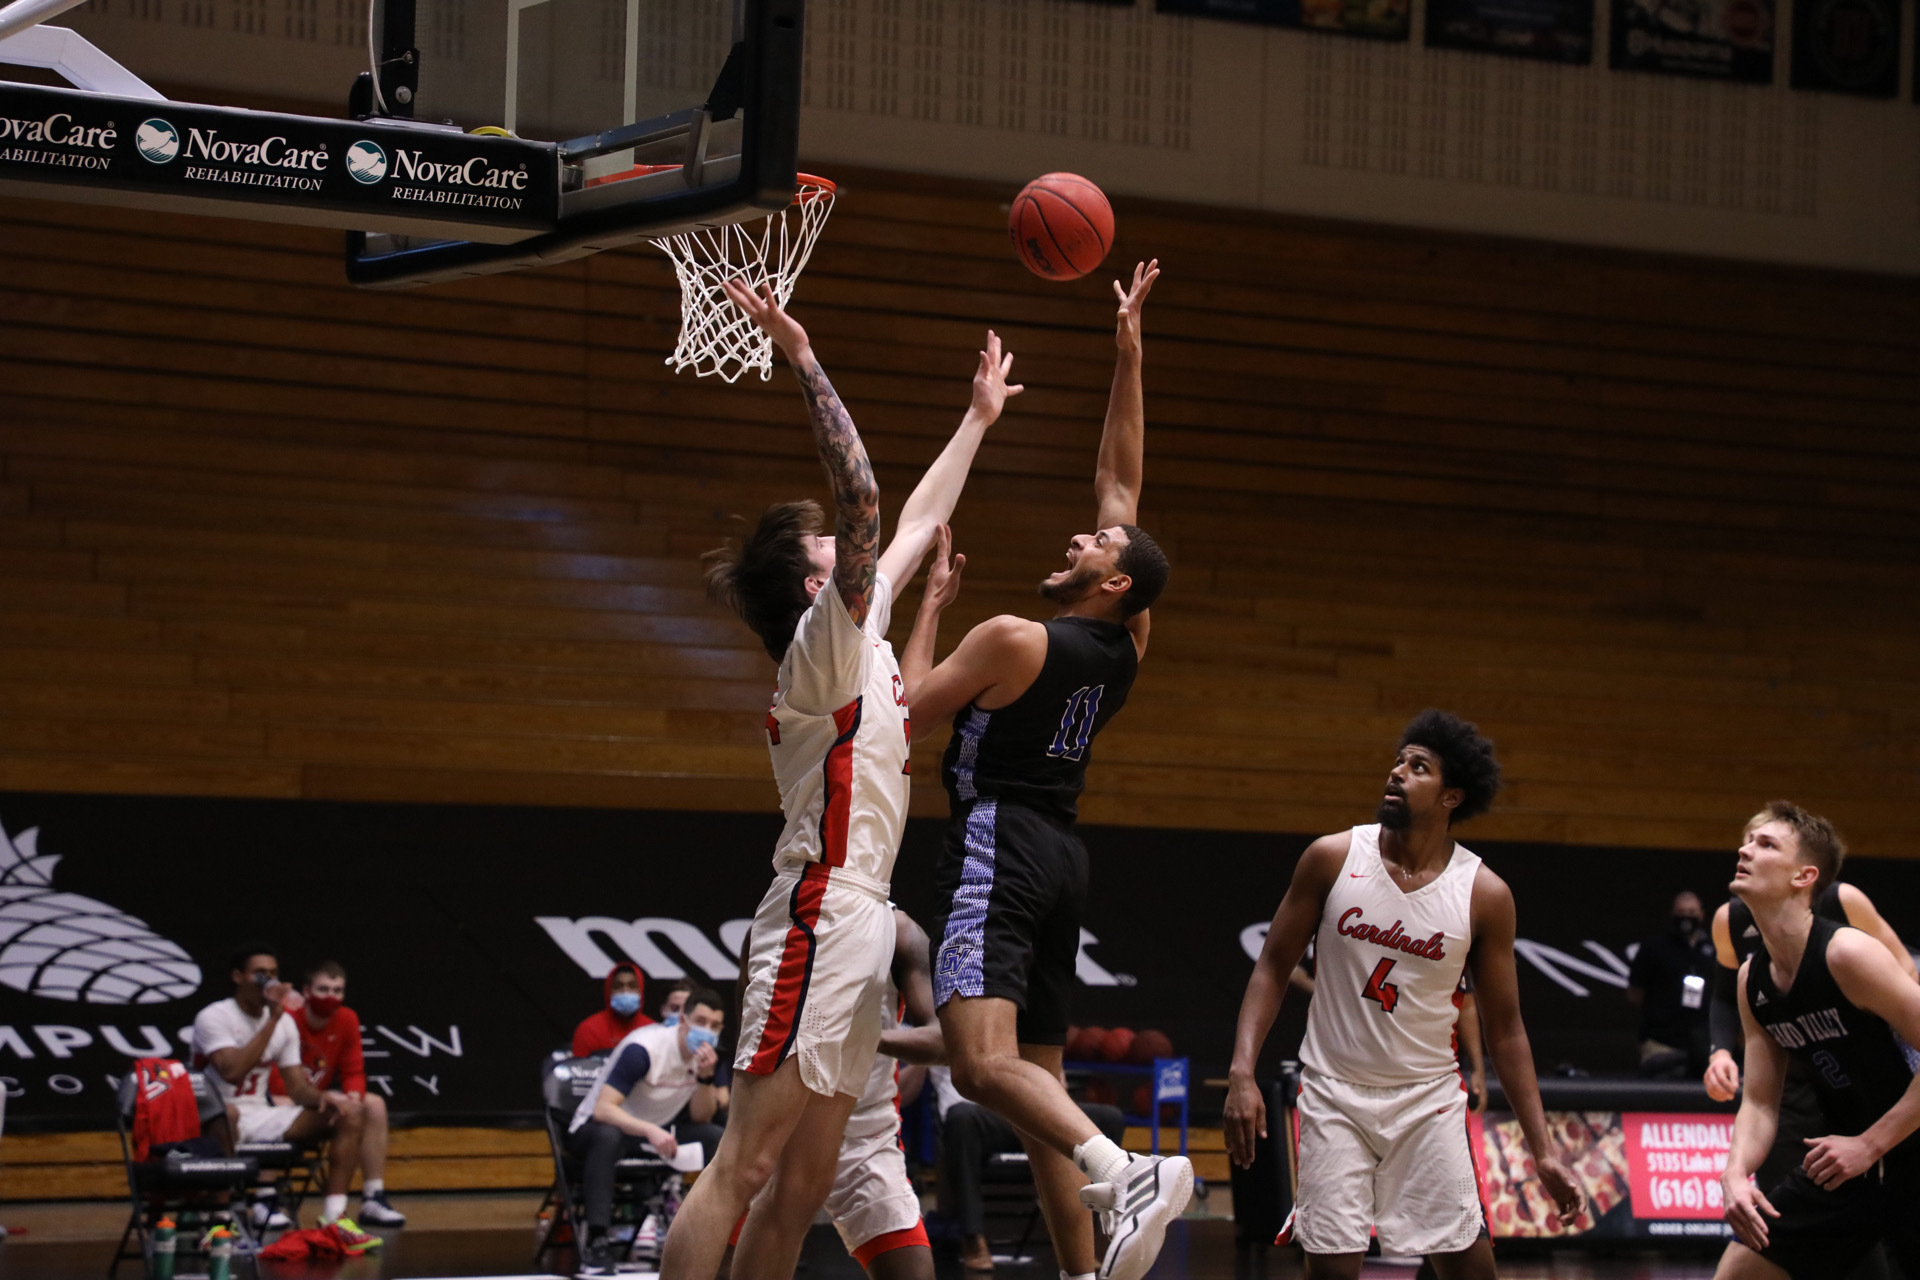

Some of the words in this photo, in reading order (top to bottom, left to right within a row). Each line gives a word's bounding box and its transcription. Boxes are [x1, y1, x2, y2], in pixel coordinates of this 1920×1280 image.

[0, 113, 117, 149] ovaCare
[0, 148, 111, 170] ABILITATION
[183, 128, 329, 171] NovaCare
[184, 166, 323, 191] REHABILITATION
[390, 149, 529, 190] NovaCare
[392, 187, 523, 210] REHABILITATION
[1046, 684, 1105, 762] 11
[1337, 907, 1446, 961] Cardinals
[940, 945, 974, 975] GV
[1361, 957, 1400, 1013] 4
[1796, 1007, 1848, 1042] VALLEY
[1812, 1049, 1852, 1089] 2
[1647, 1152, 1681, 1173] 5135
[1681, 1152, 1713, 1173] Lake
[1650, 1174, 1704, 1211] (616)
